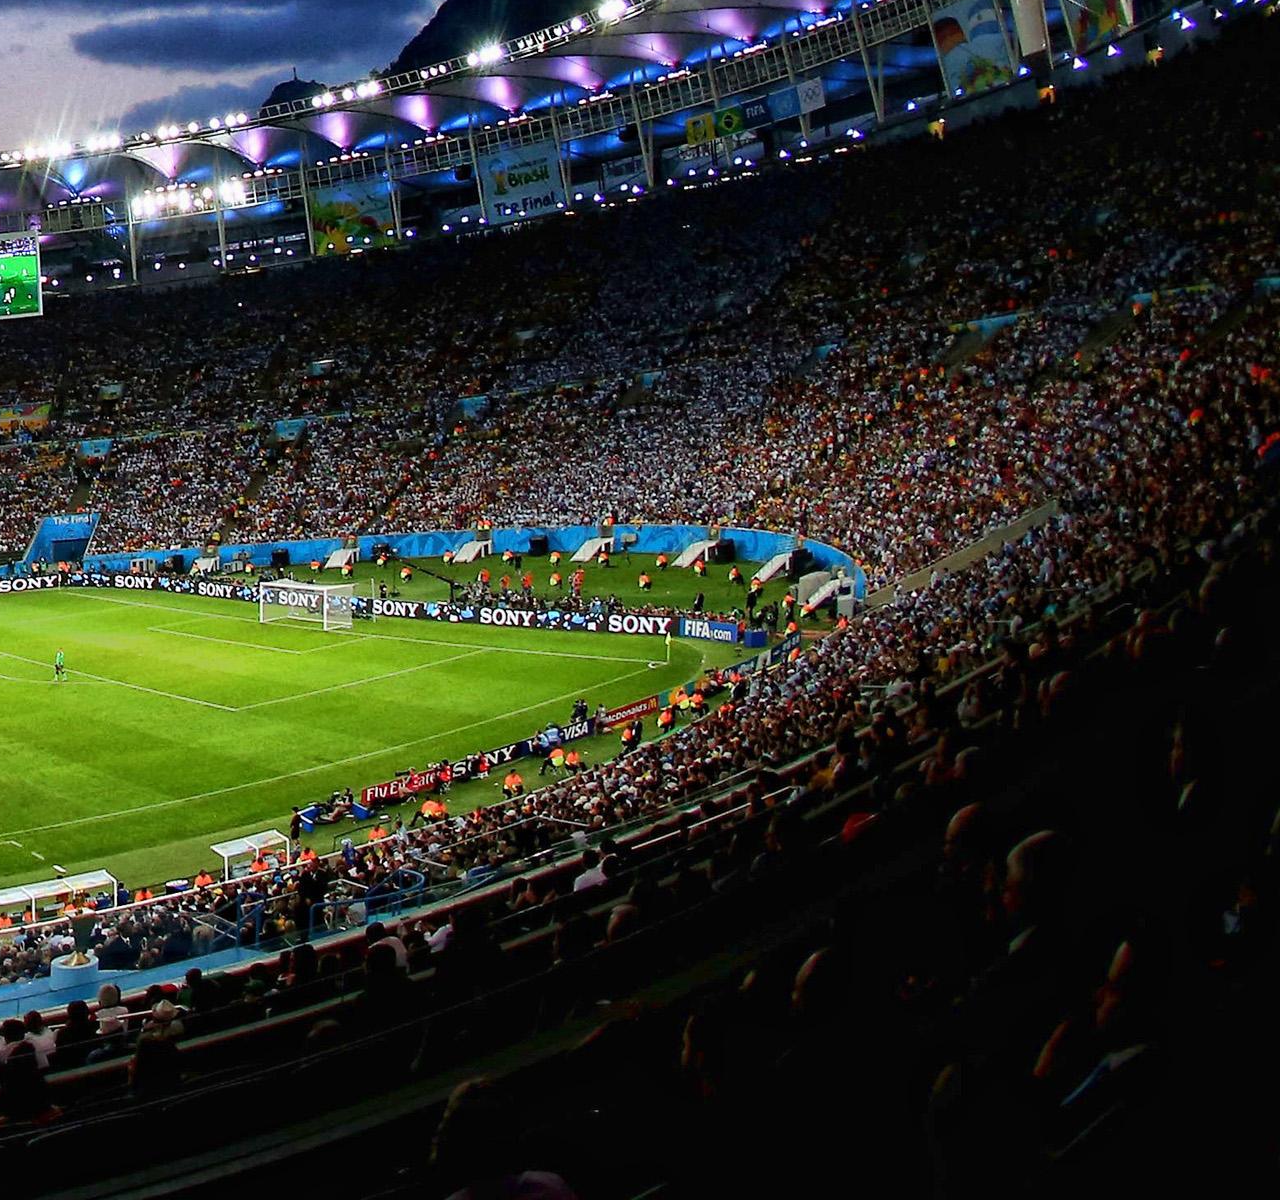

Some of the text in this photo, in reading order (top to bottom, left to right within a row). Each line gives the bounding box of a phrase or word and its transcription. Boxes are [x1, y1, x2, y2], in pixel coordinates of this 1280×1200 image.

[746, 104, 766, 119] FIFA
[522, 190, 556, 212] Final
[114, 575, 154, 589] SONY
[198, 582, 234, 598] SONY
[278, 591, 320, 608] SONY
[372, 600, 419, 617] SONY
[480, 608, 534, 627] SONY
[608, 615, 671, 634] SONY
[562, 721, 589, 741] VISA
